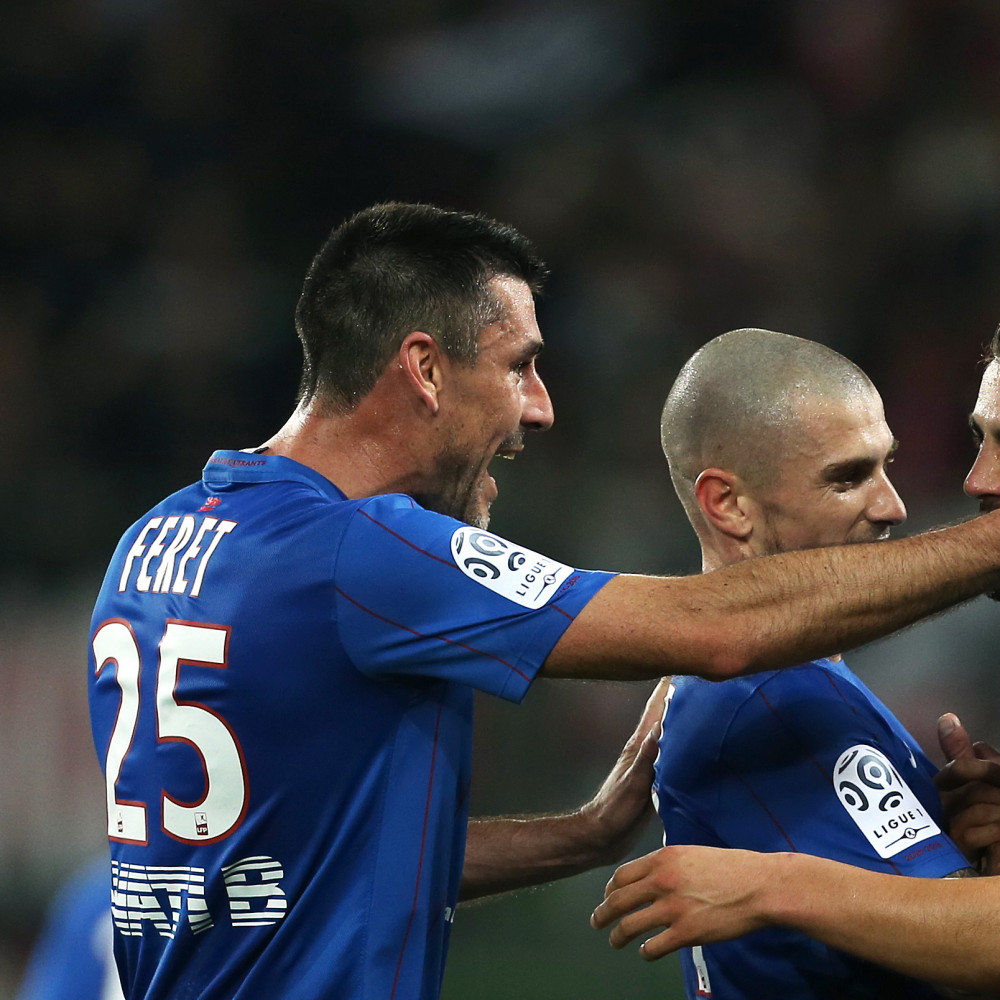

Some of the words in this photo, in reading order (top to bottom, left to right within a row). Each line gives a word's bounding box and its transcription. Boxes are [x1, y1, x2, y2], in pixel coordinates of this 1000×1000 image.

[118, 514, 239, 598] FERET
[515, 561, 547, 597] LIGUE
[92, 617, 250, 846] 25
[873, 810, 917, 839] LIGUE
